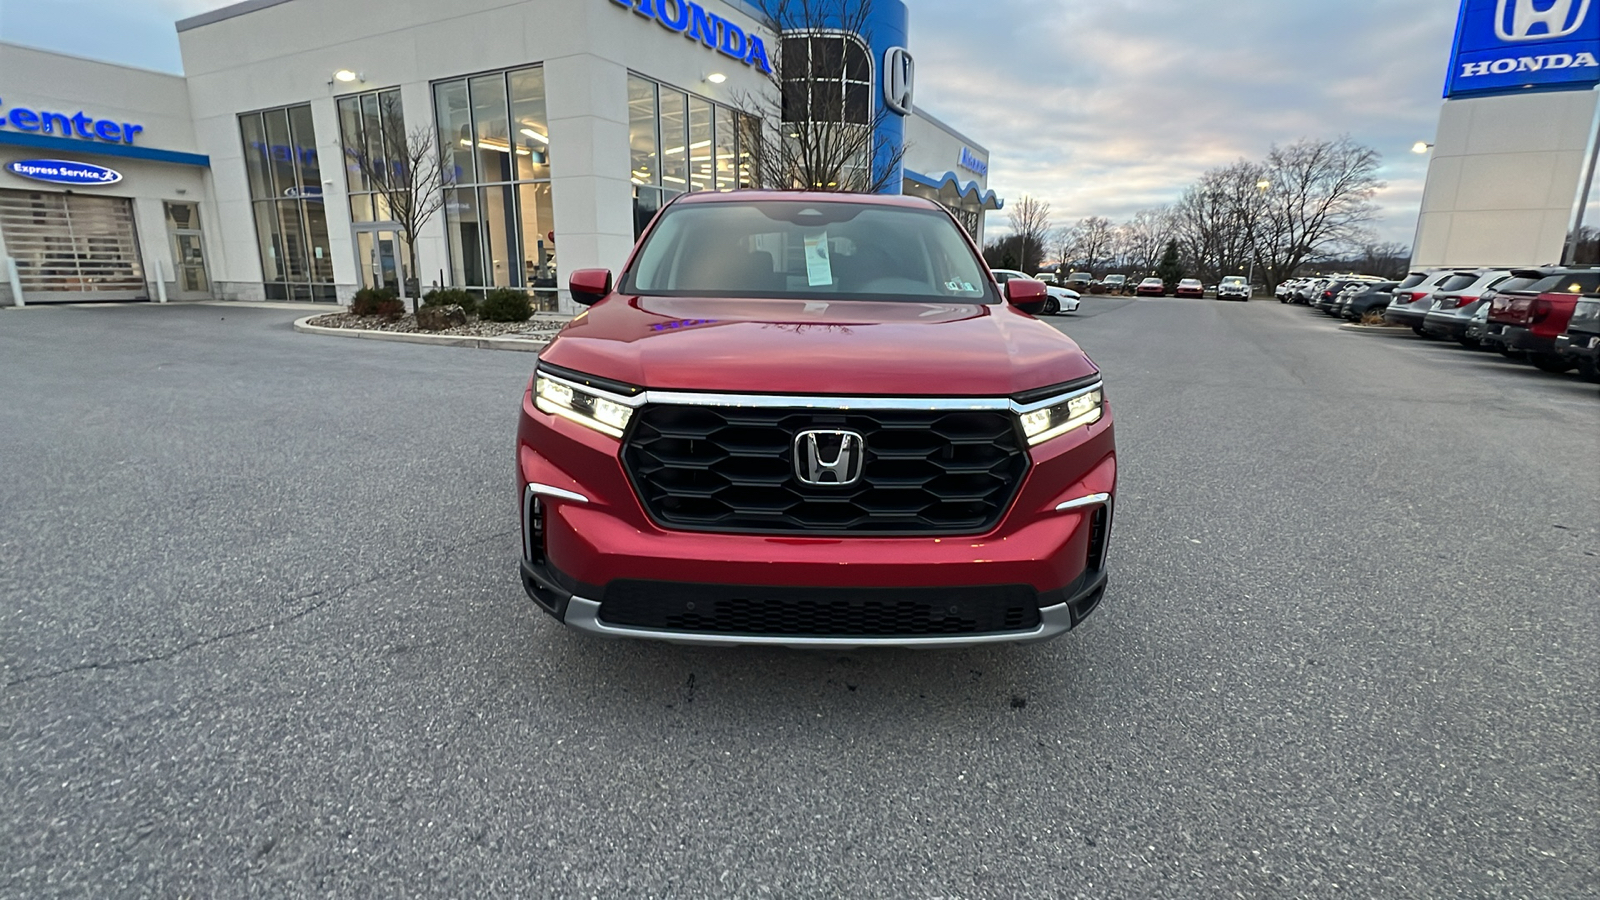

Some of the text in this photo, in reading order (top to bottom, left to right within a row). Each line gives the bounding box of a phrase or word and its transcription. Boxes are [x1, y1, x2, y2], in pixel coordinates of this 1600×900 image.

[1460, 52, 1599, 77] HONDA
[0, 98, 143, 144] enter
[13, 162, 100, 180] Express Service
